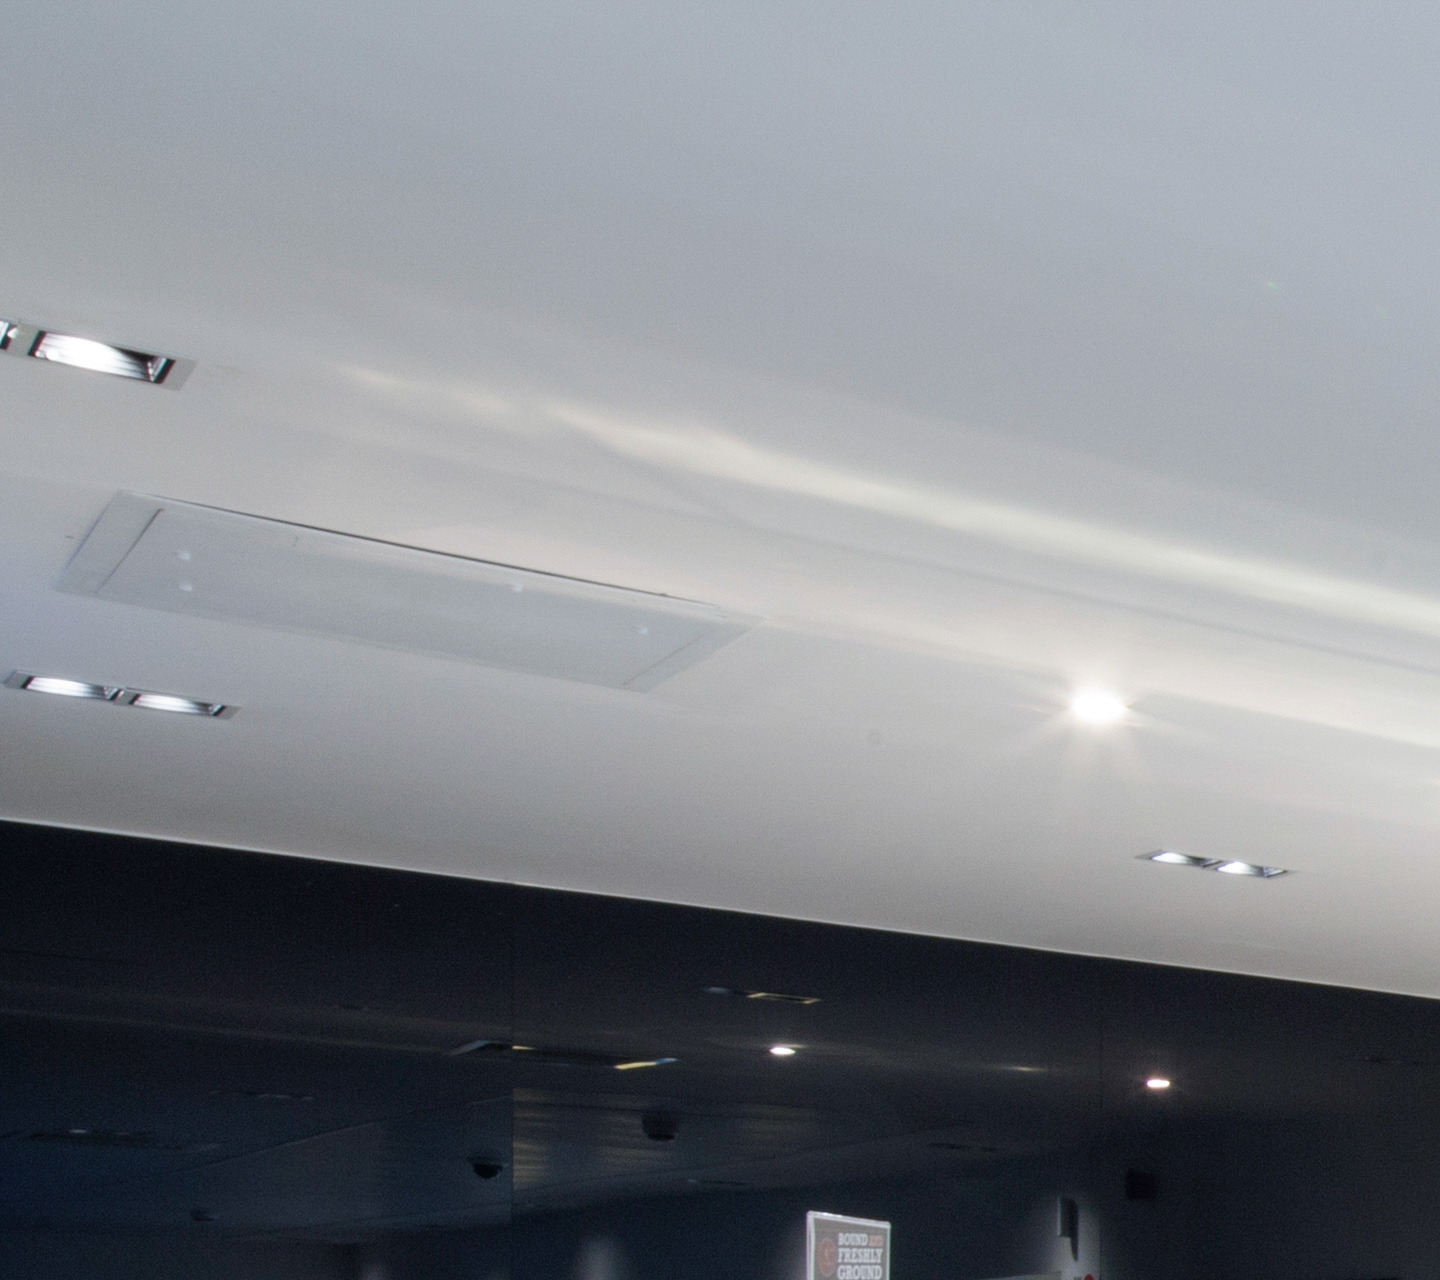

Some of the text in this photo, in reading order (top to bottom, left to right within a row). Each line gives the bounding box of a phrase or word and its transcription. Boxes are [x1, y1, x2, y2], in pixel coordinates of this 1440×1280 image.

[838, 1233, 868, 1246] BOUND
[837, 1248, 883, 1263] FRESHLY
[837, 1265, 883, 1280] GROUND
